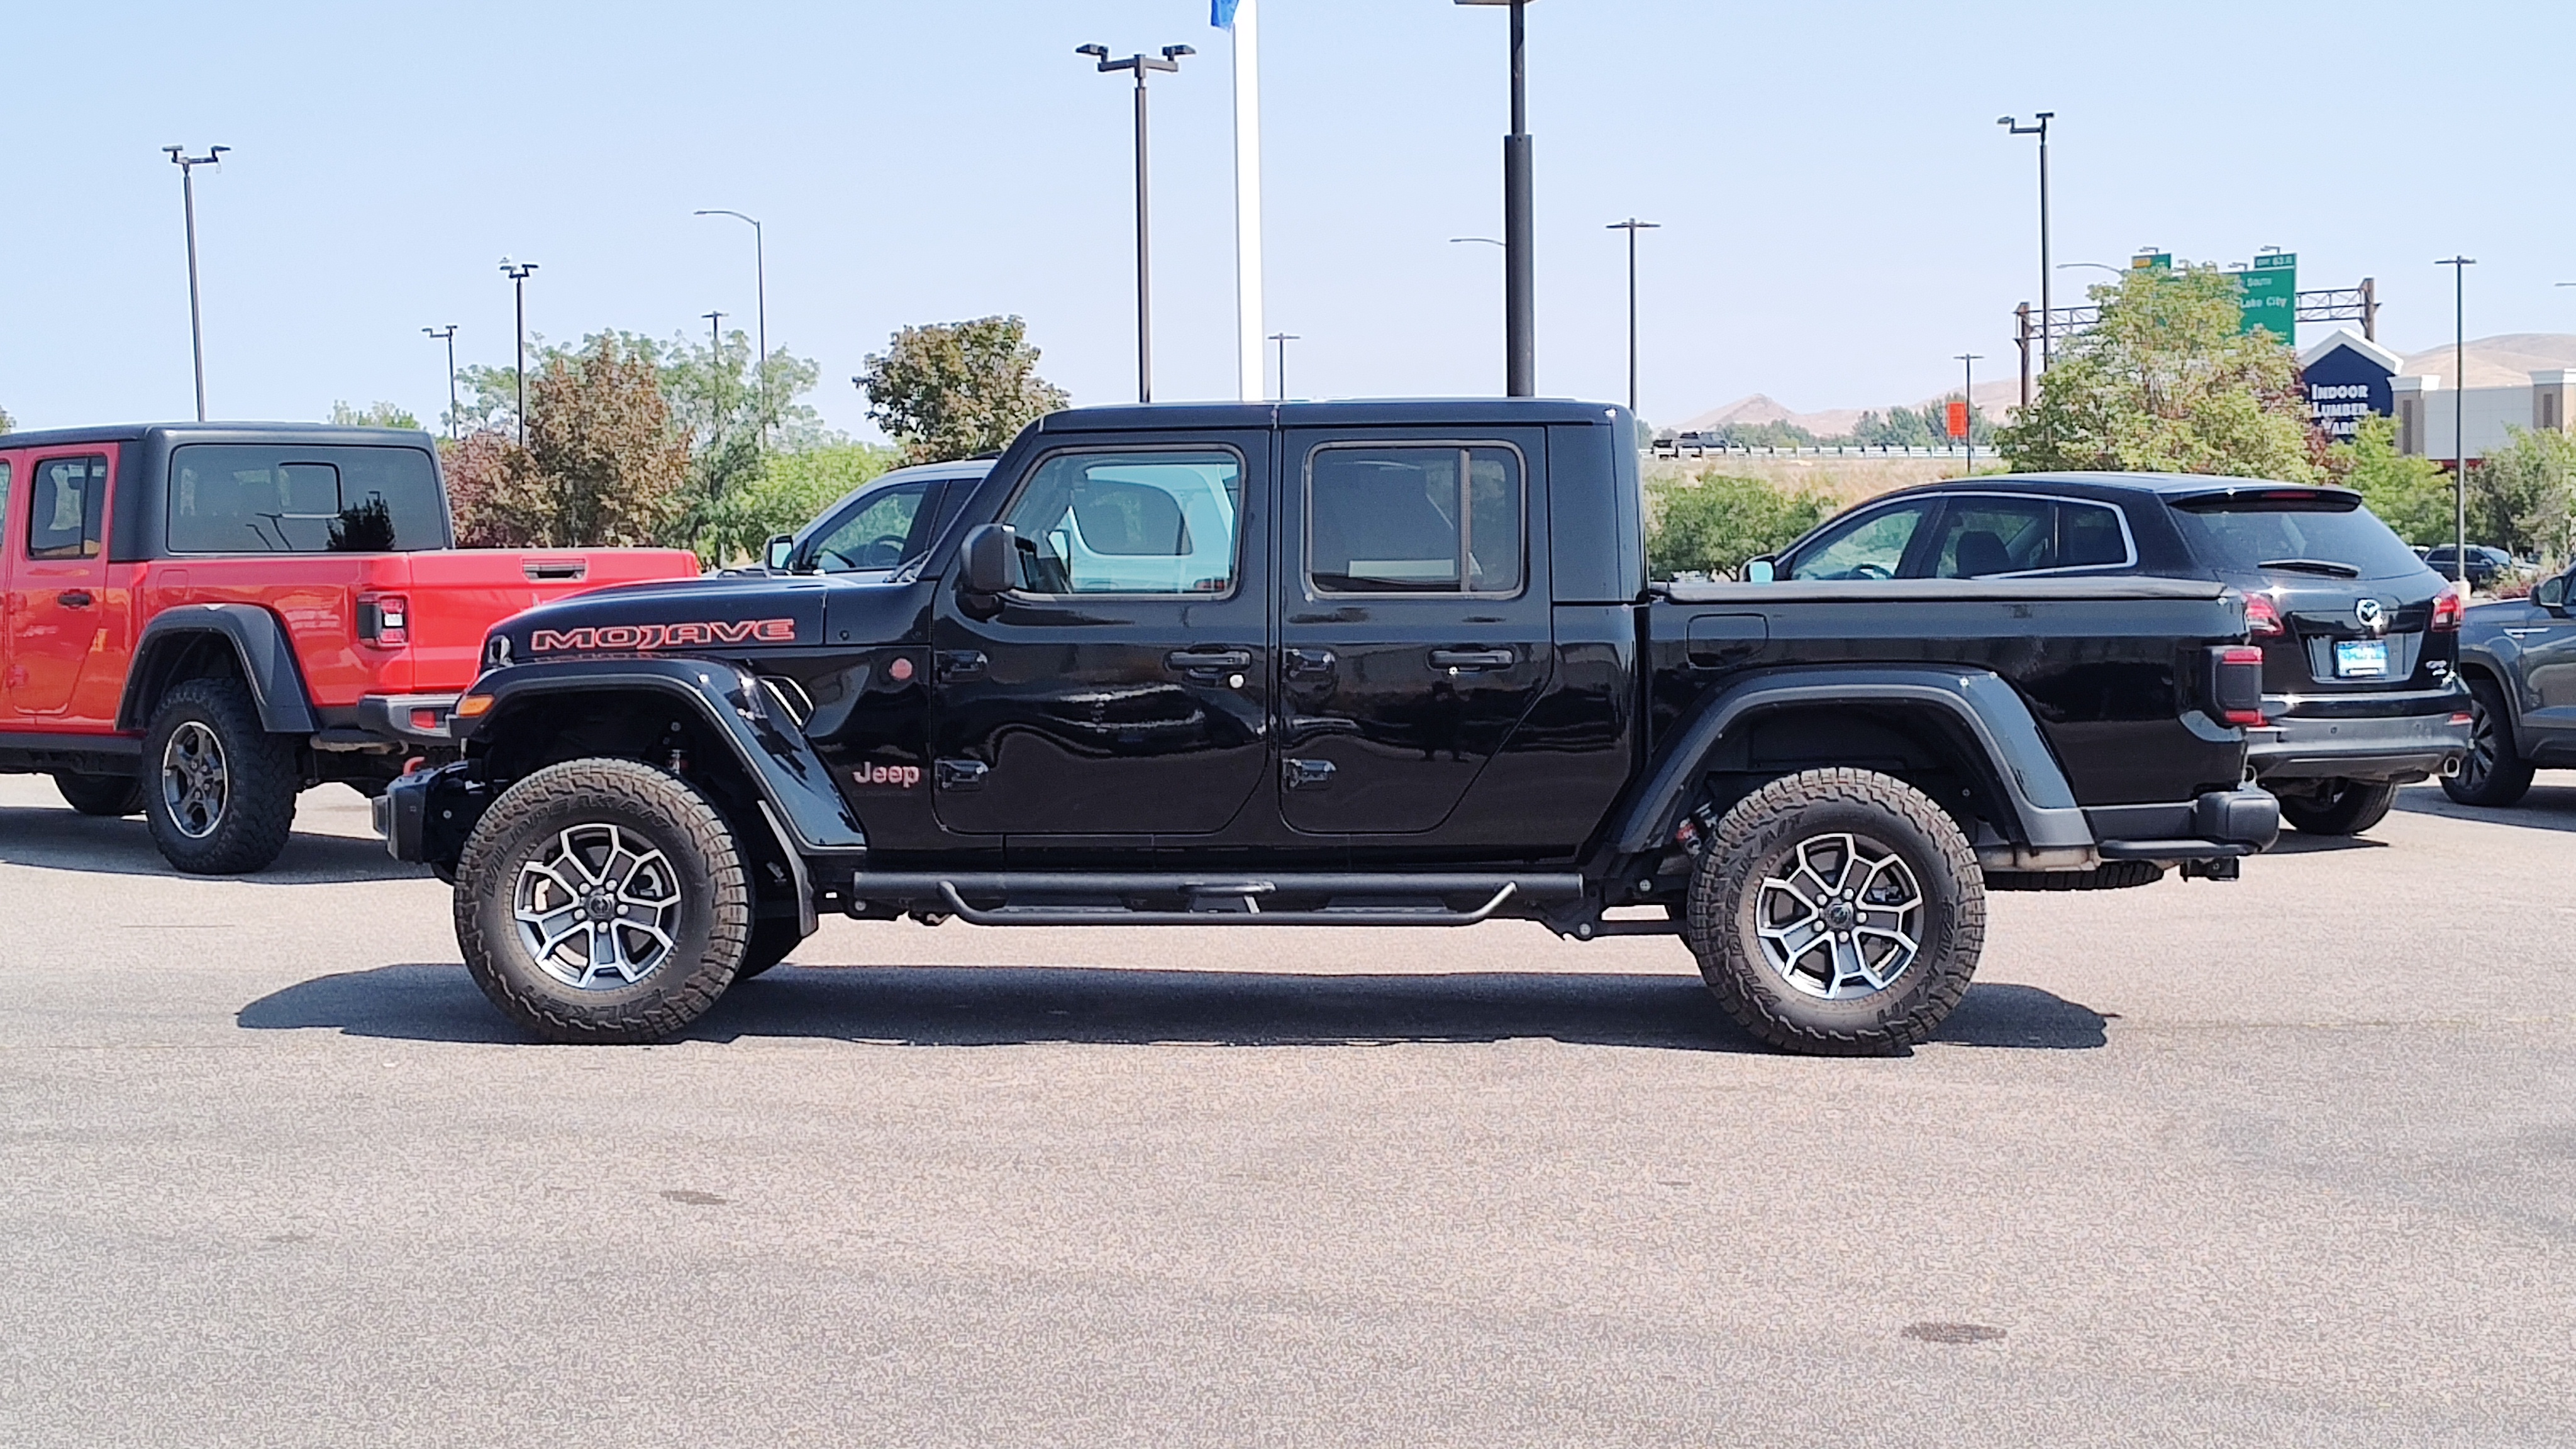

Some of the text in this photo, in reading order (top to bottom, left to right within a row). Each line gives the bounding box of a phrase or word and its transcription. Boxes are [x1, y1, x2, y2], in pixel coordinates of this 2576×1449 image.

[2266, 296, 2287, 308] City
[2311, 384, 2368, 400] INDOOR
[531, 619, 794, 650] MOJAVE
[853, 762, 919, 788] Jeep
[1725, 847, 1781, 1002] WILDPEAK
